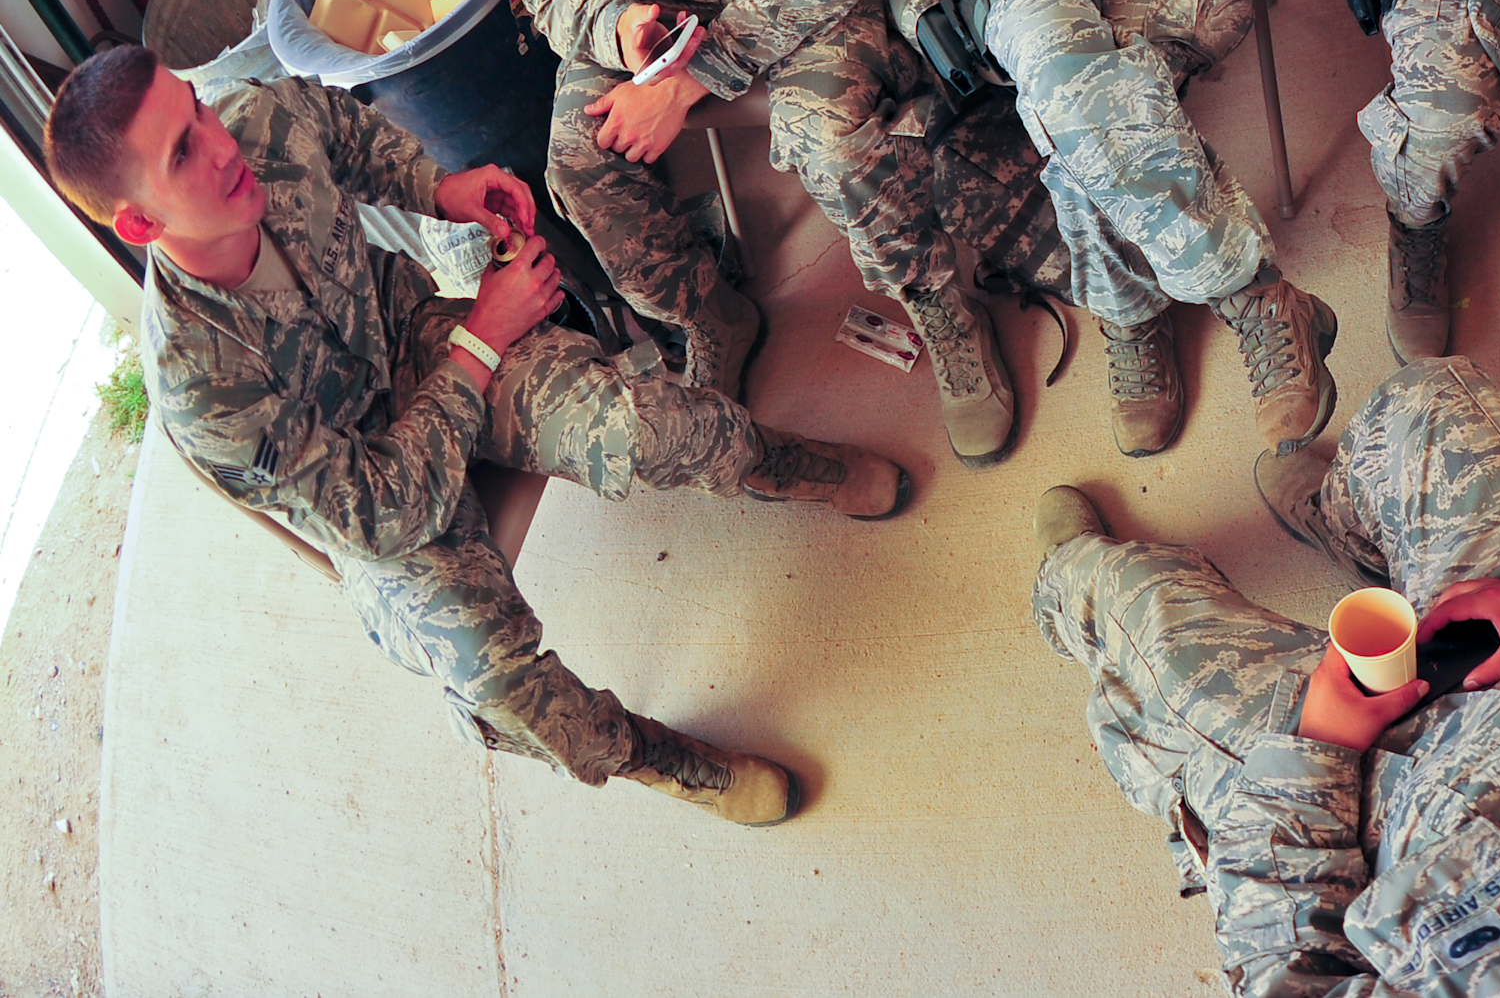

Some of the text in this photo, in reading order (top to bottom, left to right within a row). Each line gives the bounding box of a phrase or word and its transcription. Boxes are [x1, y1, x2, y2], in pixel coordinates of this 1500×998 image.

[323, 246, 339, 275] U.S.
[331, 216, 347, 245] AIR
[1443, 895, 1479, 923] AIR
